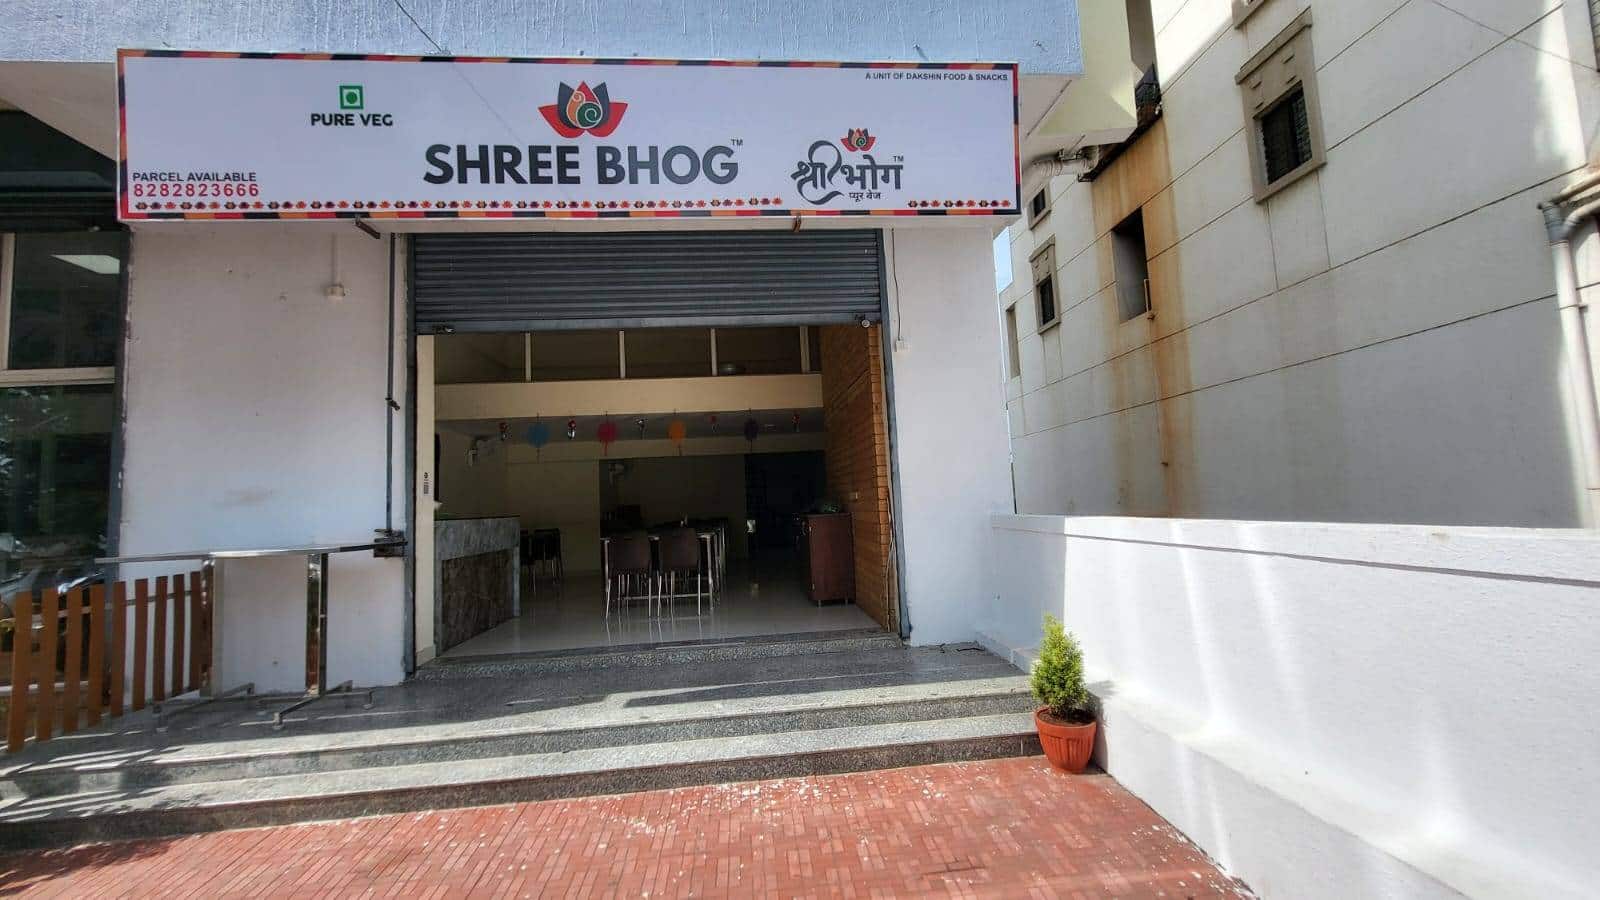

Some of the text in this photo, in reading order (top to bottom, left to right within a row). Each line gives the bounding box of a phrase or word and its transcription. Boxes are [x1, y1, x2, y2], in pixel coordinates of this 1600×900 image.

[976, 73, 1008, 81] SNACKS
[311, 114, 393, 126] PURE VEG
[424, 144, 581, 184] SHREE
[598, 145, 738, 184] BHOG
[133, 173, 256, 182] PARCEL AVAILABLE
[134, 184, 258, 197] 8282823666
